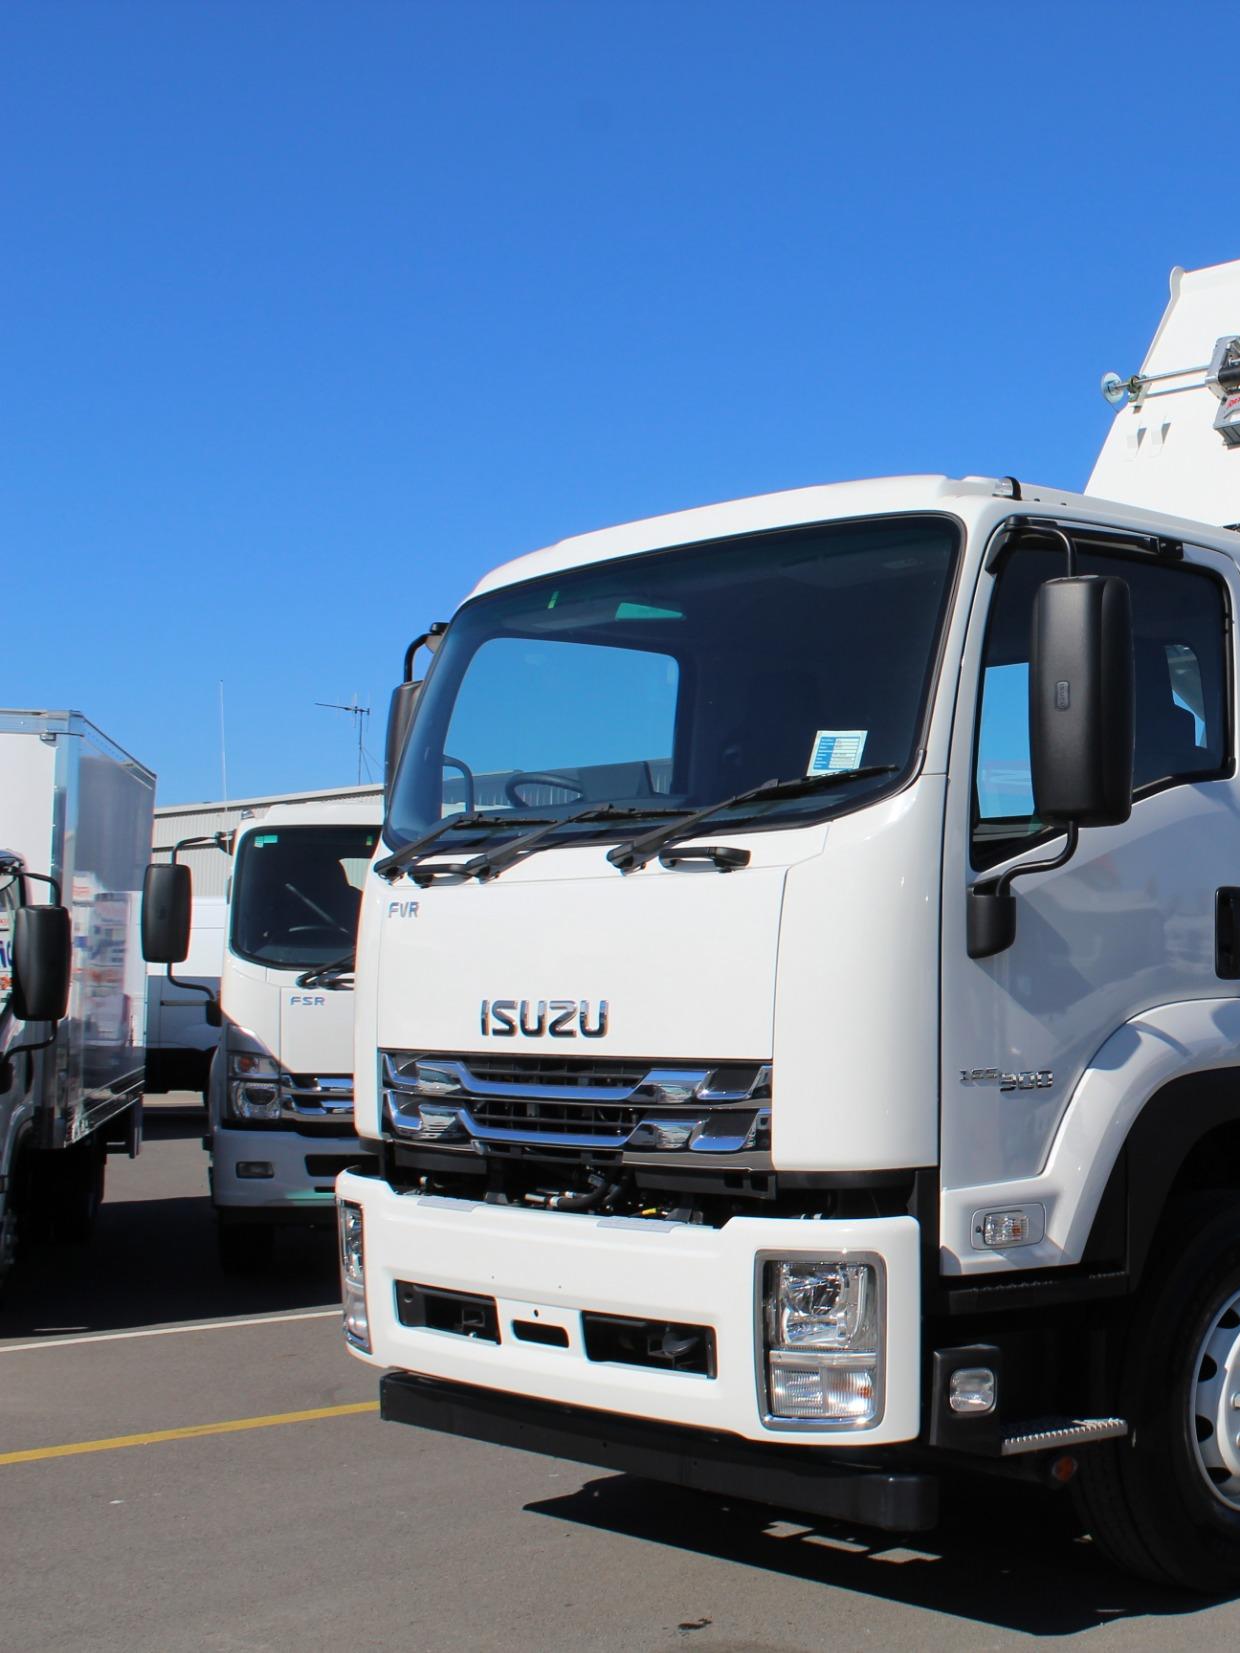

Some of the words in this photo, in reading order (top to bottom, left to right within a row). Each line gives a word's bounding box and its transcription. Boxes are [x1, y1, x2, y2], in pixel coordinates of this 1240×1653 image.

[388, 901, 420, 918] FVR
[290, 996, 326, 1006] FSR
[481, 999, 609, 1038] ISUZU
